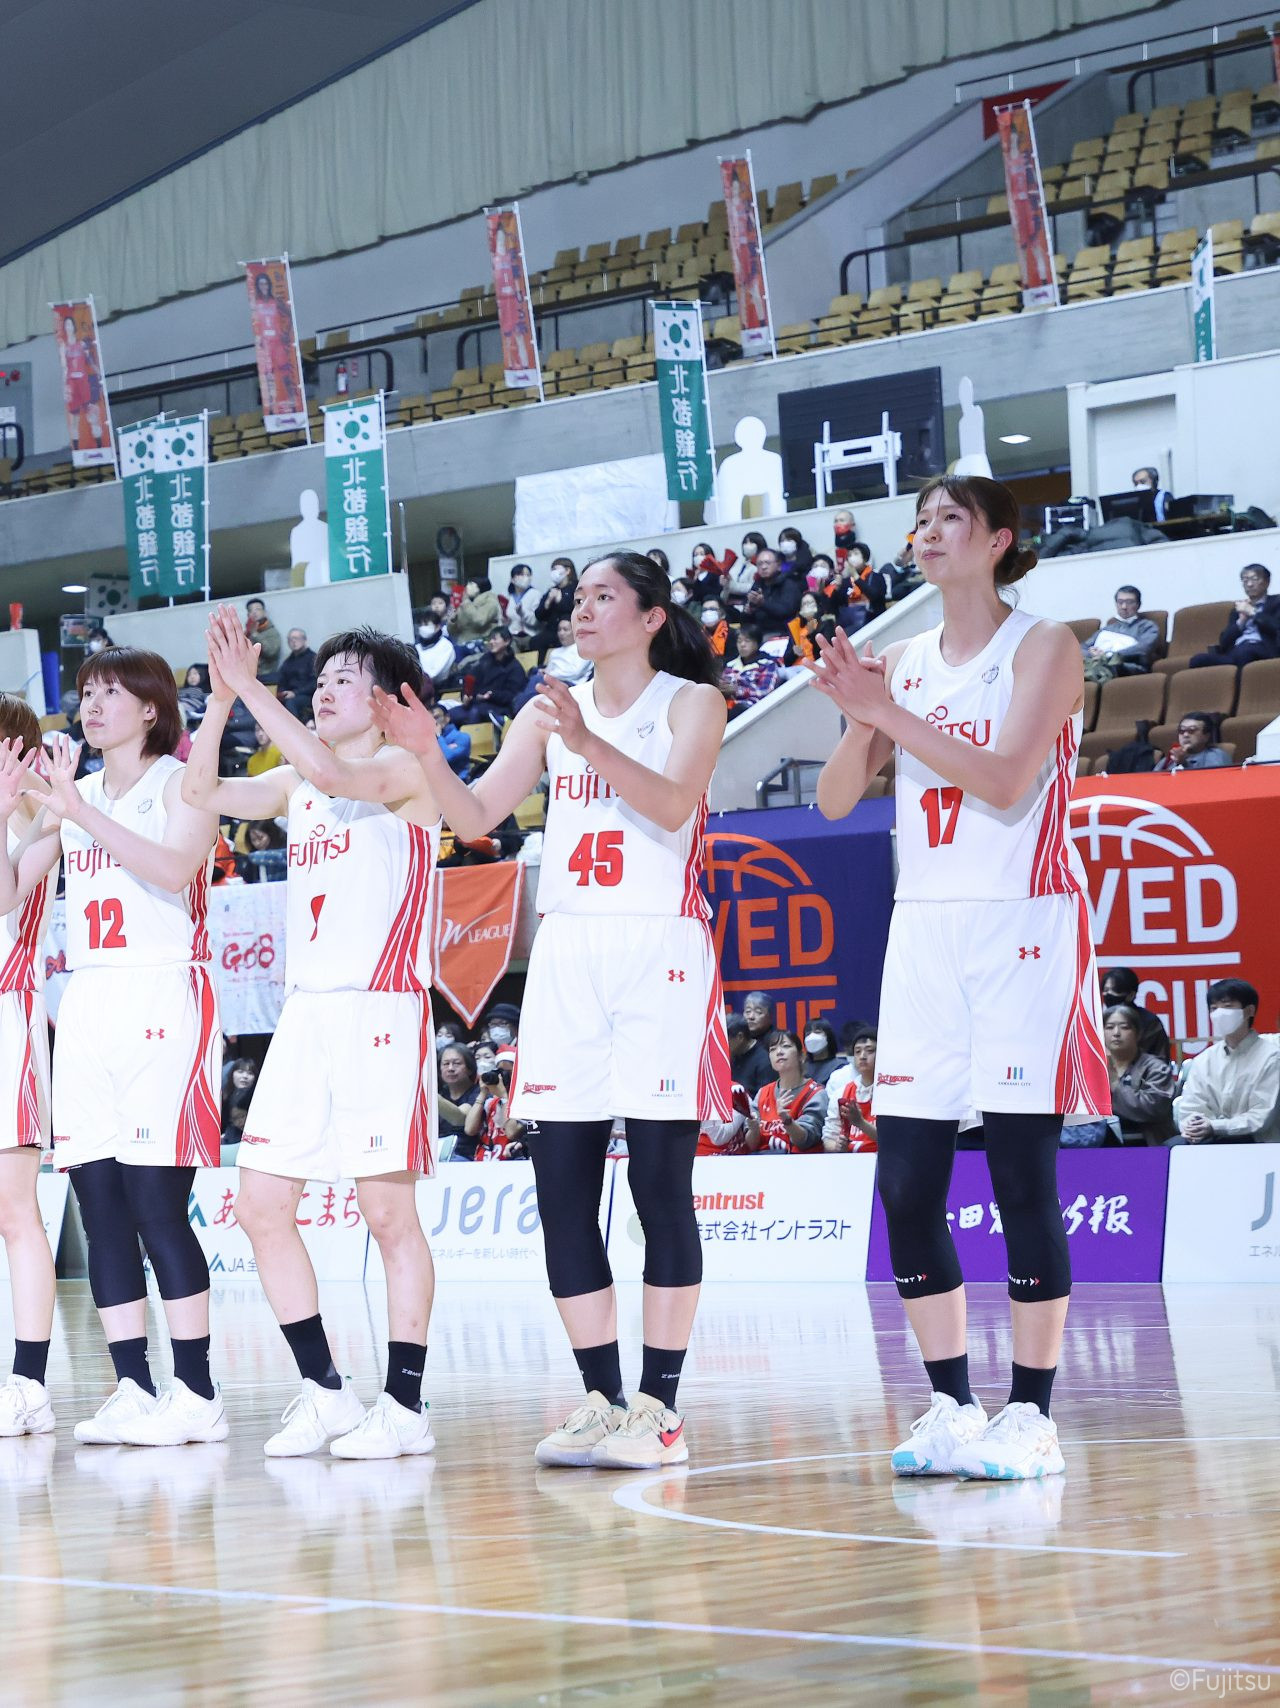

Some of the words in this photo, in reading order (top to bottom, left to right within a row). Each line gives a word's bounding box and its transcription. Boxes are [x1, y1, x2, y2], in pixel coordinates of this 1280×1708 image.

[920, 786, 963, 848] 17
[568, 830, 624, 887] 45
[83, 898, 127, 949] 12
[1084, 864, 1238, 945] VED
[468, 922, 512, 944] LEAGUE
[213, 1186, 361, 1230] あこまち
